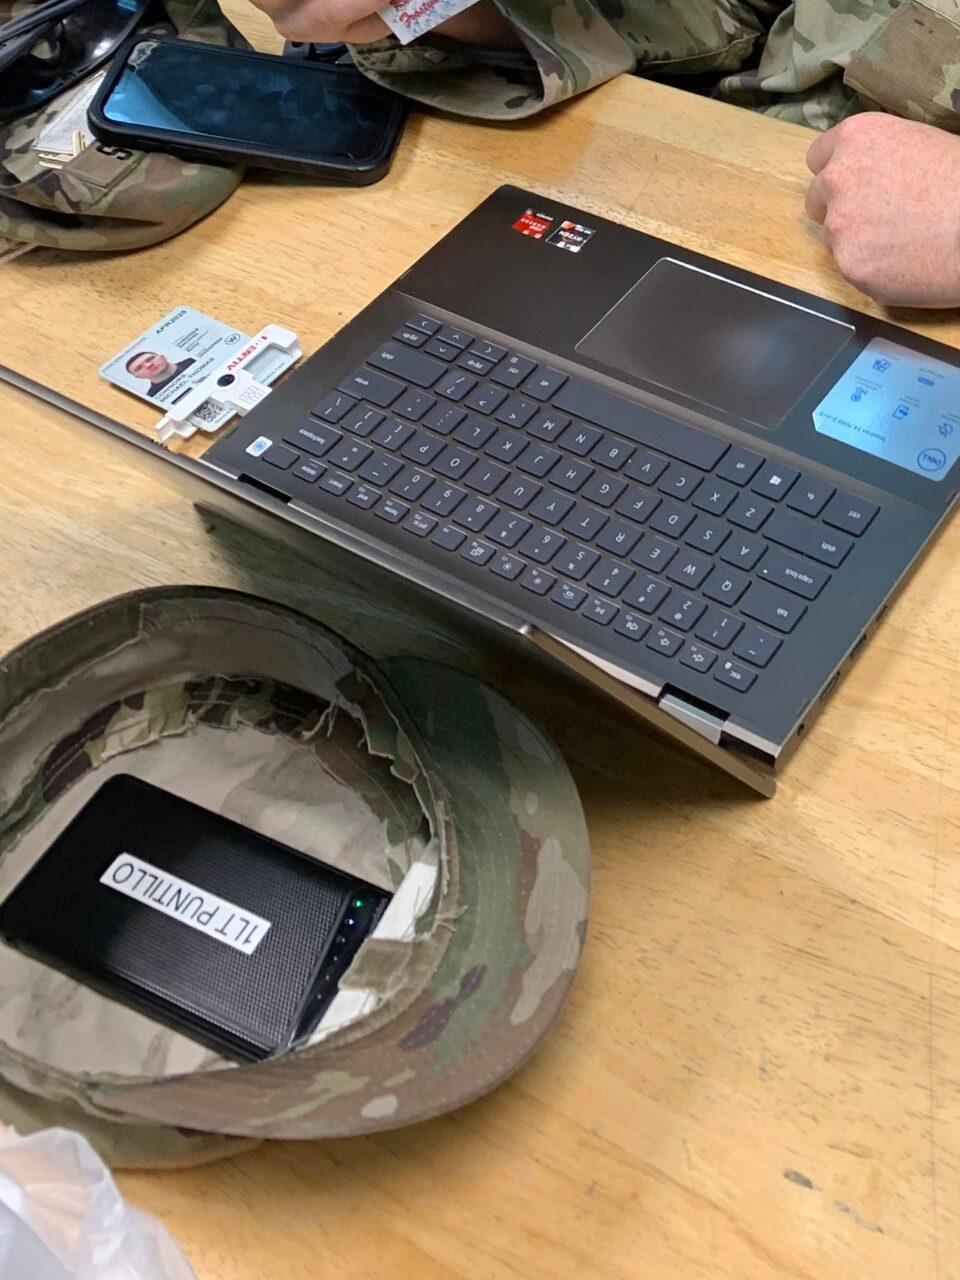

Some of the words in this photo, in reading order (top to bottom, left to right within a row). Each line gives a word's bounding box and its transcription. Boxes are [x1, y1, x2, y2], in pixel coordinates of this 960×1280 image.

[299, 428, 325, 445] backspace
[112, 862, 220, 926] PUNTILLO
[215, 913, 258, 945] 1LT
